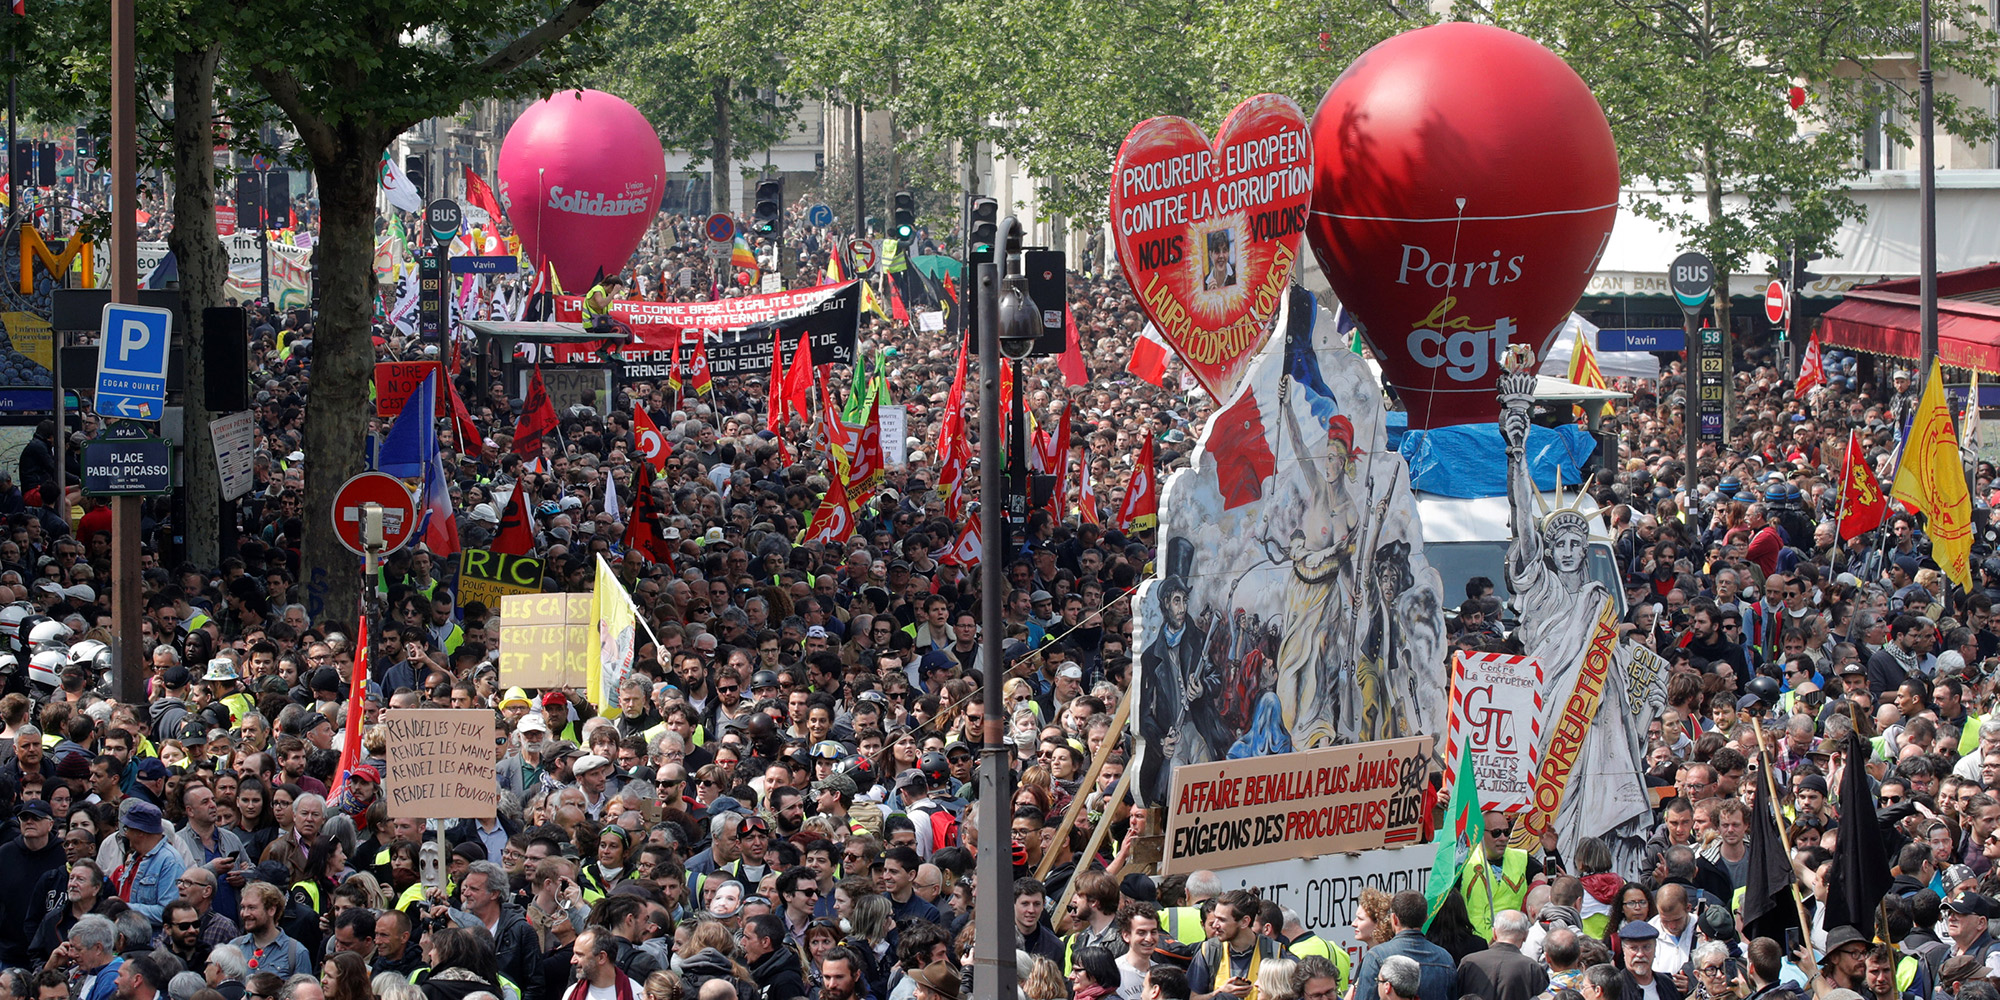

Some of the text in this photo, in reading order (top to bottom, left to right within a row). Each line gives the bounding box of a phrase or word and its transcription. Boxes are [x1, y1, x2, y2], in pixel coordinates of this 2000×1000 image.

[1123, 125, 1307, 199] PROCUREUR EUROPÉEN
[625, 181, 644, 190] Union
[548, 185, 648, 216] Solidaires
[1121, 164, 1314, 237] CONTRE LA CORRUPTION
[432, 209, 457, 222] BUS
[1139, 204, 1307, 271] NOUS VOULONS
[20, 222, 94, 294] M
[424, 259, 437, 268] 58
[472, 261, 496, 269] Vavin
[1395, 243, 1525, 288] Paris
[1675, 265, 1709, 282] BUS
[424, 279, 437, 289] 82
[1588, 277, 1667, 290] CAN BAR
[425, 301, 436, 311] 91
[563, 300, 582, 312] LA
[642, 305, 685, 314] COMME
[675, 316, 694, 325] LA
[822, 297, 847, 312] BUT
[1143, 272, 1194, 348] LAURA
[1412, 296, 1517, 330] la
[119, 319, 150, 362] P
[681, 326, 747, 345] CNT
[1626, 333, 1657, 346] Vavin
[1704, 332, 1720, 344] 58
[653, 350, 671, 360] DE
[720, 347, 737, 357] DE
[740, 339, 798, 356] CLASES
[821, 333, 838, 346] DE
[833, 345, 850, 362] 94
[1406, 316, 1517, 382] cgt
[391, 365, 422, 379] DIRE
[1704, 359, 1719, 371] 82
[102, 378, 160, 392] EDGAR QUINET
[543, 373, 604, 391] RAVAIL
[1704, 386, 1719, 399] 91
[110, 452, 144, 463] PLACE
[86, 465, 168, 476] PABLO PICASSO
[465, 549, 540, 585] RIC
[462, 579, 487, 592] POUR
[489, 584, 504, 593] UNE
[502, 597, 593, 620] LES CASS
[540, 626, 565, 645] LES
[501, 653, 531, 674] ET
[1479, 661, 1515, 674] Contre
[1633, 646, 1662, 673] ONU
[1464, 669, 1479, 681] La
[387, 717, 485, 742] RENDEZ LES YEUX
[1523, 621, 1618, 838] CORRUPTION
[390, 741, 492, 763] RENDEZ LES MAINS
[391, 761, 434, 782] RENDEZ
[439, 760, 456, 774] LES
[458, 762, 494, 780] ARMES
[1474, 768, 1518, 781] AUNES
[1177, 771, 1243, 815] AFFAIRE
[1243, 767, 1313, 806] BENALLA
[1315, 765, 1350, 797] PLUS
[1350, 750, 1400, 792] JAMAIS
[1488, 780, 1527, 794] JUSTICE
[392, 782, 496, 807] RENDEZ LE POUVOIR
[1172, 817, 1252, 859] EXIGEONS
[1253, 813, 1285, 847] DES
[1285, 800, 1388, 841] PROCUREURS
